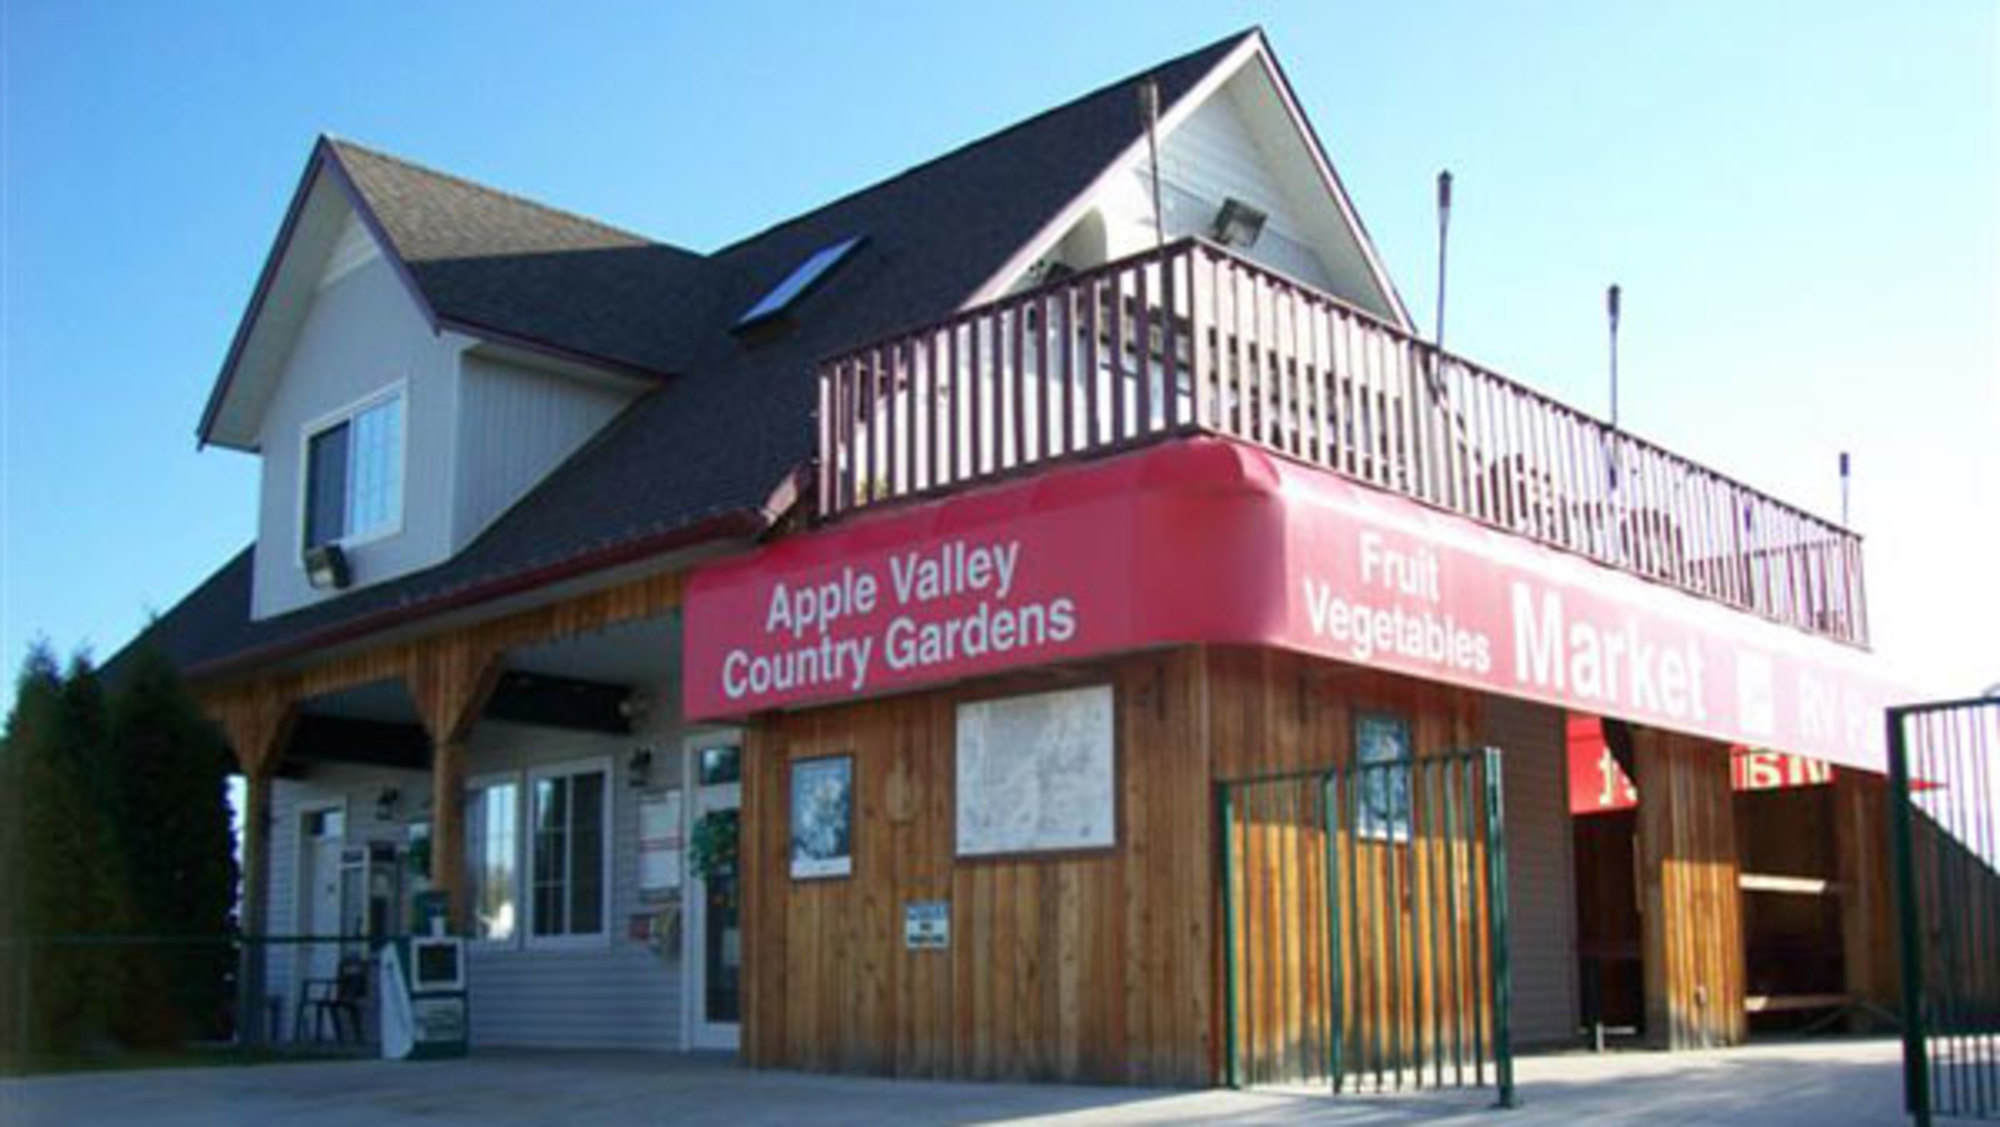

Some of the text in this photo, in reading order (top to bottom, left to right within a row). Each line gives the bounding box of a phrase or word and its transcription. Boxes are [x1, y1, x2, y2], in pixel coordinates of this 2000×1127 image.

[766, 540, 1021, 638] Apple Valley
[1358, 531, 1441, 601] Fruit
[722, 597, 1077, 698] Country Gardens
[1305, 577, 1491, 673] Vegetables
[1512, 580, 1708, 721] Market
